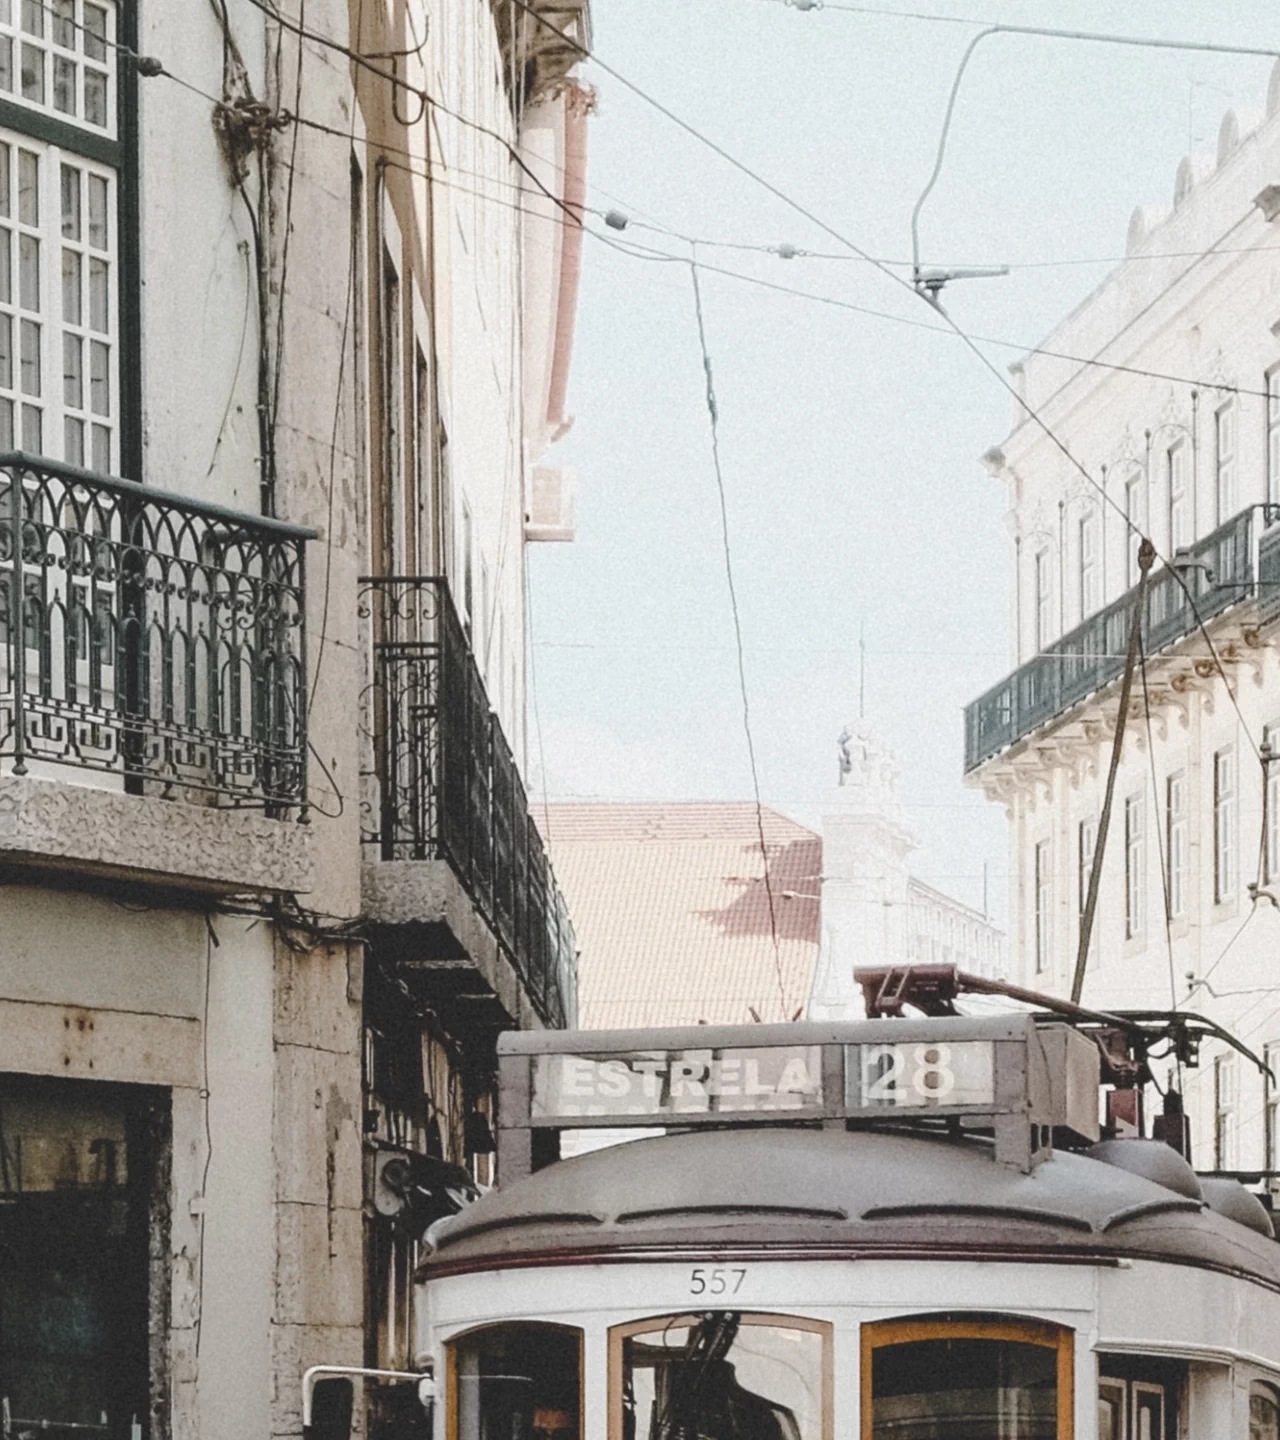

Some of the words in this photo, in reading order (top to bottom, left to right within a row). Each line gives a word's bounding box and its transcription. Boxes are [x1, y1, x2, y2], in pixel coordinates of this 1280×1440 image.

[563, 1057, 809, 1098] ESTRELA
[867, 1044, 955, 1101] 28
[689, 1269, 747, 1295] 557
